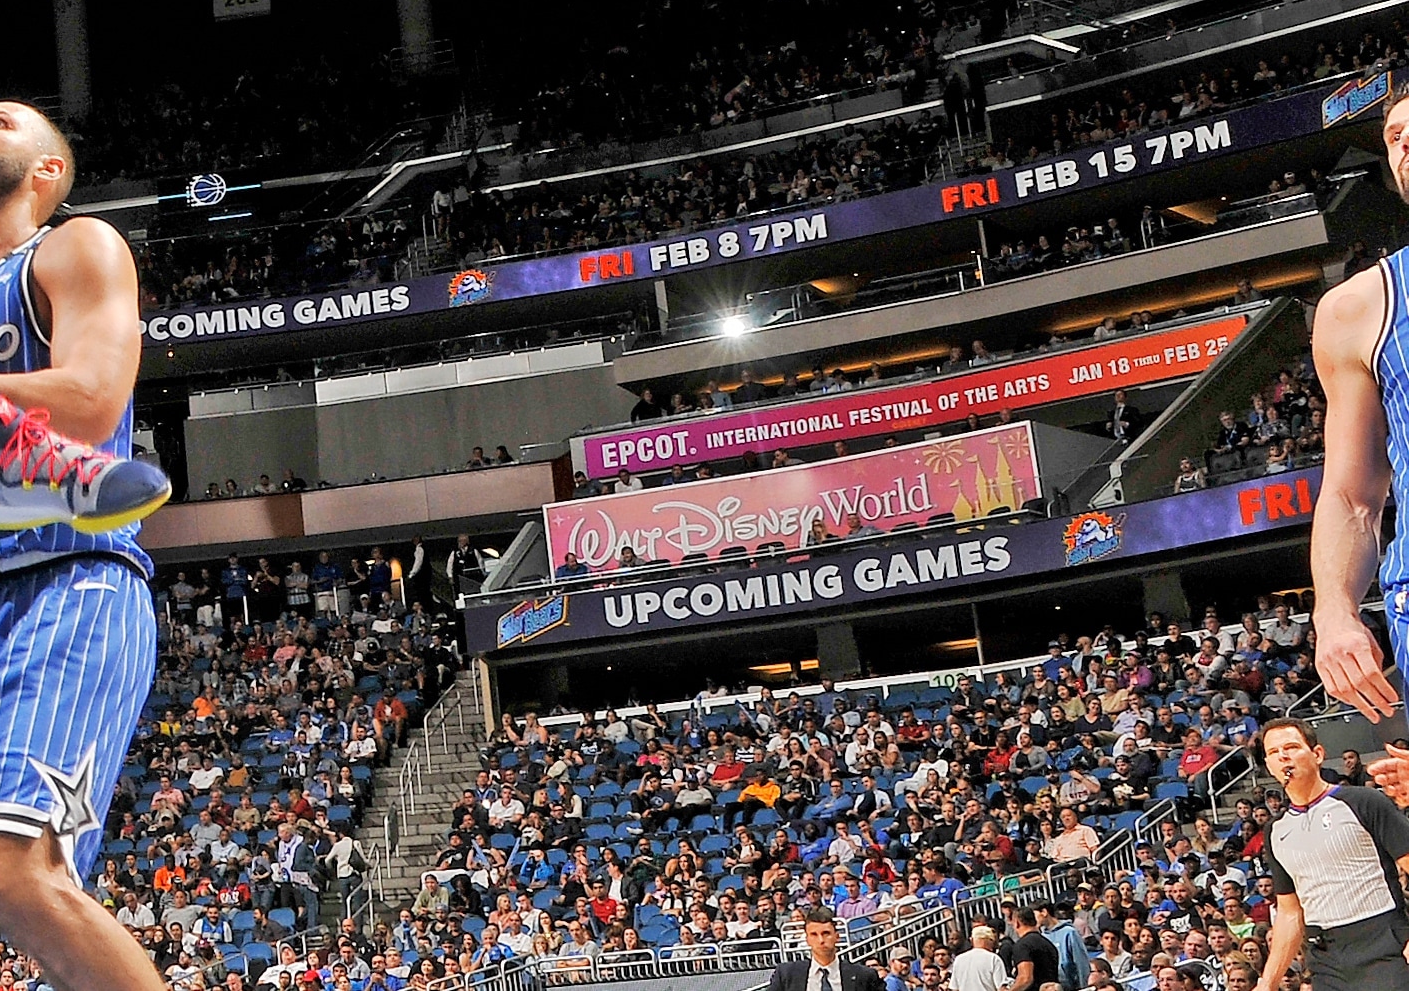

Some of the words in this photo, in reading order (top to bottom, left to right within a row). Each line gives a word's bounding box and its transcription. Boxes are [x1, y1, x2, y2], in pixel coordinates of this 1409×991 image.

[940, 177, 1000, 214] FRI
[1014, 161, 1081, 200] FEB
[1087, 145, 1138, 180] 15
[1143, 118, 1233, 166] 7PM
[578, 251, 634, 282] FRI
[648, 236, 710, 272] FEB
[718, 228, 741, 258] 8
[747, 212, 830, 252] 7PM
[140, 302, 286, 342] COMING
[292, 284, 411, 324] GAMES
[706, 413, 844, 449] INTERNATIONAL
[848, 399, 932, 427] FESTIVAL
[937, 392, 960, 411] OF
[964, 384, 999, 406] THE
[1003, 374, 1050, 398] ARTS
[1068, 364, 1103, 385] JAN
[1107, 357, 1131, 376] 18
[1133, 354, 1160, 368] THRU
[1163, 343, 1201, 366] FEB
[1204, 336, 1229, 356] 25
[819, 473, 934, 527] World
[1238, 478, 1313, 527] FRI
[603, 562, 850, 628] UPCOMING
[854, 536, 1011, 592] GAMES
